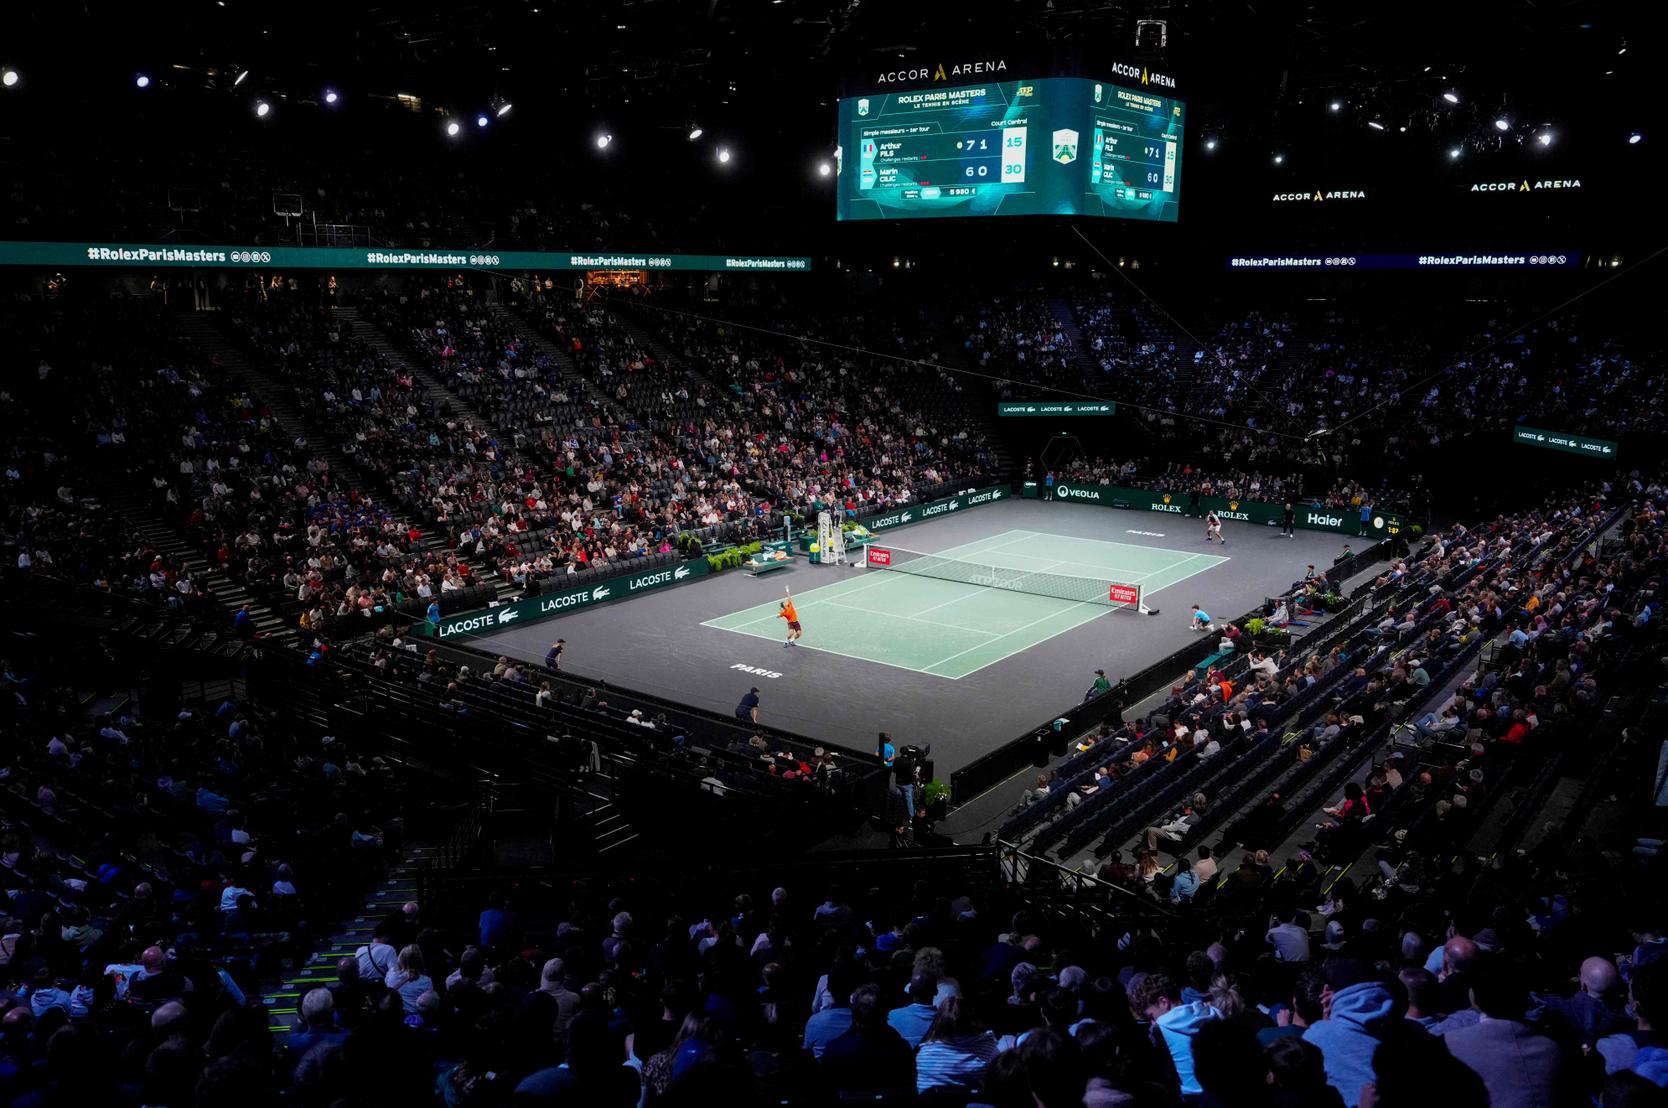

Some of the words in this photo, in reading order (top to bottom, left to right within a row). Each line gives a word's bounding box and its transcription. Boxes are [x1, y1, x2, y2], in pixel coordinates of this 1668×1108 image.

[878, 68, 929, 84] ACCOR
[952, 60, 1007, 76] ARENA
[1112, 62, 1140, 79] ACCOR
[1150, 73, 1176, 88] ARENA
[898, 95, 924, 104] ROLEX
[925, 92, 947, 102] PARIS
[949, 88, 986, 100] MASTERS
[991, 119, 1006, 127] Court
[1007, 118, 1028, 126] Central
[880, 142, 902, 150] Arthur
[967, 140, 975, 151] 7
[980, 139, 987, 150] 1
[1007, 137, 1022, 148] 15
[1149, 147, 1154, 157] 7
[966, 167, 974, 177] 6
[978, 166, 987, 176] 0
[1005, 164, 1022, 174] 30
[1147, 172, 1152, 182] 6
[1153, 173, 1158, 183] 0
[1471, 182, 1516, 192] ACCOR
[1534, 180, 1581, 189] ARENA
[1272, 192, 1311, 201] ACCOR
[1326, 190, 1365, 199] ARENA
[88, 247, 226, 263] #RolexParisMasters
[367, 252, 467, 265] #RolexParisMasters
[571, 256, 646, 267] #RolexParisMasters
[1418, 255, 1525, 266] #RolexParisMasters
[725, 259, 785, 269] #RolexParisMasters
[1231, 257, 1321, 267] #RolexParisMasters
[1518, 431, 1537, 440] LACOSTE
[1548, 437, 1568, 446] LACOSTE
[1581, 443, 1602, 452] LACOSTE
[968, 493, 991, 504] LACOSTE
[1069, 489, 1100, 500] VEOLIA
[923, 503, 948, 516] LACOSTE
[1151, 503, 1182, 513] ROLEX
[1217, 510, 1249, 520] ROLEX
[1308, 513, 1343, 527] Haier
[872, 515, 899, 529] LACOSTE
[629, 571, 671, 590] LACOSTE
[541, 591, 589, 612] LACOSTE
[439, 614, 494, 638] LACOSTE
[729, 663, 783, 679] PARIS
